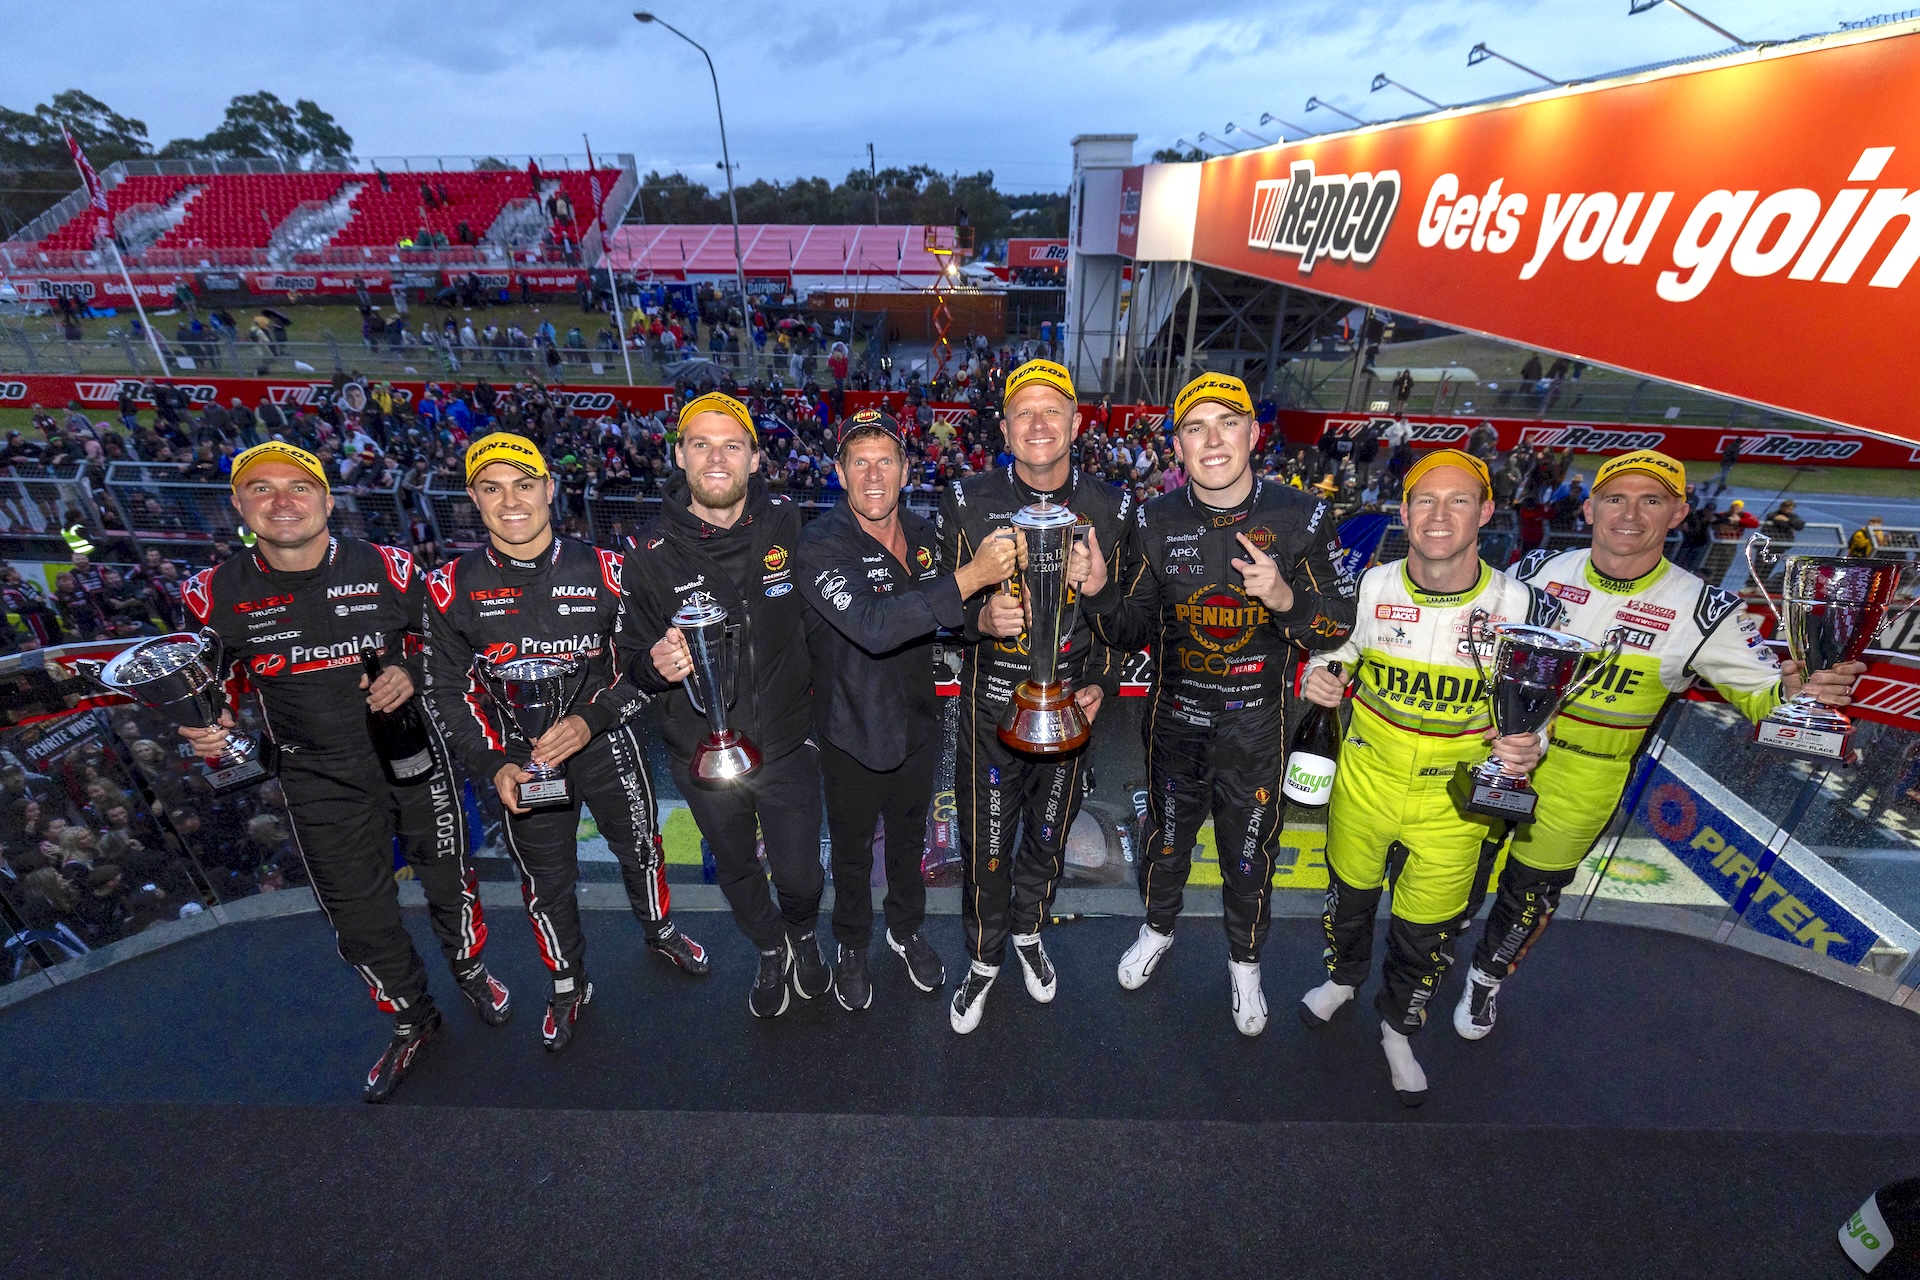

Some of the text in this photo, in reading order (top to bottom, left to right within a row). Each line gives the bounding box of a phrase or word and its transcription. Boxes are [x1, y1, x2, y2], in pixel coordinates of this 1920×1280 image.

[1275, 165, 1398, 268] Repco
[1417, 174, 1528, 252] Gets
[1519, 192, 1674, 280] you
[1046, 246, 1068, 262] Rep
[275, 275, 316, 290] Repco
[747, 282, 785, 295] BATHURST
[1009, 365, 1068, 387] DUNLOP
[1178, 380, 1242, 407] DUNLOP
[852, 409, 882, 422] PENRITE
[1369, 419, 1468, 442] Rpco
[1563, 426, 1664, 451] Repco
[468, 441, 534, 464] DUNLOP
[1759, 435, 1861, 459] Repco
[1603, 456, 1680, 475] DUNLOP
[952, 480, 966, 508] HRX
[1117, 489, 1132, 521] HRX
[1212, 515, 1235, 528] 100
[1307, 501, 1328, 534] HRX
[1166, 533, 1199, 543] Steadfast
[1244, 533, 1277, 542] PENRITE
[1169, 547, 1200, 559] APEX
[867, 568, 889, 579] APEX
[327, 582, 379, 599] NULON
[552, 586, 598, 599] NULON
[674, 581, 703, 593] Steadfast
[770, 585, 789, 596] Ford
[1599, 579, 1636, 591] TRADIE
[470, 587, 522, 600] ISUZU
[1424, 595, 1463, 604] TRADIE
[1561, 591, 1587, 604] JACKS
[233, 593, 295, 614] ISUZU
[350, 604, 374, 613] RACING
[482, 598, 515, 606] TRUCKS
[1391, 606, 1418, 614] HUNGRY
[1641, 602, 1676, 616] TOYOTA
[248, 605, 287, 619] TRUCKS
[1175, 602, 1270, 628] PENRITE
[1391, 612, 1417, 622] JACKS
[1625, 613, 1669, 631] KENWORTH
[248, 630, 302, 643] DAYCO
[521, 634, 601, 654] PremiAir
[291, 631, 386, 663] PremiAir
[326, 656, 351, 667] 1300
[993, 660, 1028, 671] AUSTRALIAN
[1225, 653, 1268, 665] Celebrating
[1234, 663, 1257, 673] YEARS
[1181, 678, 1217, 690] AUSTRALIAN
[1241, 683, 1262, 691] OWNED
[1585, 658, 1644, 696] DIE
[1245, 697, 1264, 708] MATT
[1377, 687, 1475, 714] ENERGY+
[25, 728, 75, 760] PENRITE
[1809, 745, 1835, 754] PLACE
[1289, 763, 1332, 793] Kayo
[1420, 768, 1438, 776] 20
[1287, 777, 1311, 793] SPORTS
[430, 781, 451, 813] WE
[1045, 766, 1067, 824] SINCE 1926
[990, 789, 1001, 856] SINCE 1926
[1163, 795, 1176, 847] SINCE 1926
[435, 813, 456, 858] 1300
[1243, 807, 1266, 860] INCE 1926
[1689, 825, 1849, 956] PIRTEK
[1491, 922, 1530, 965] TRADIE
